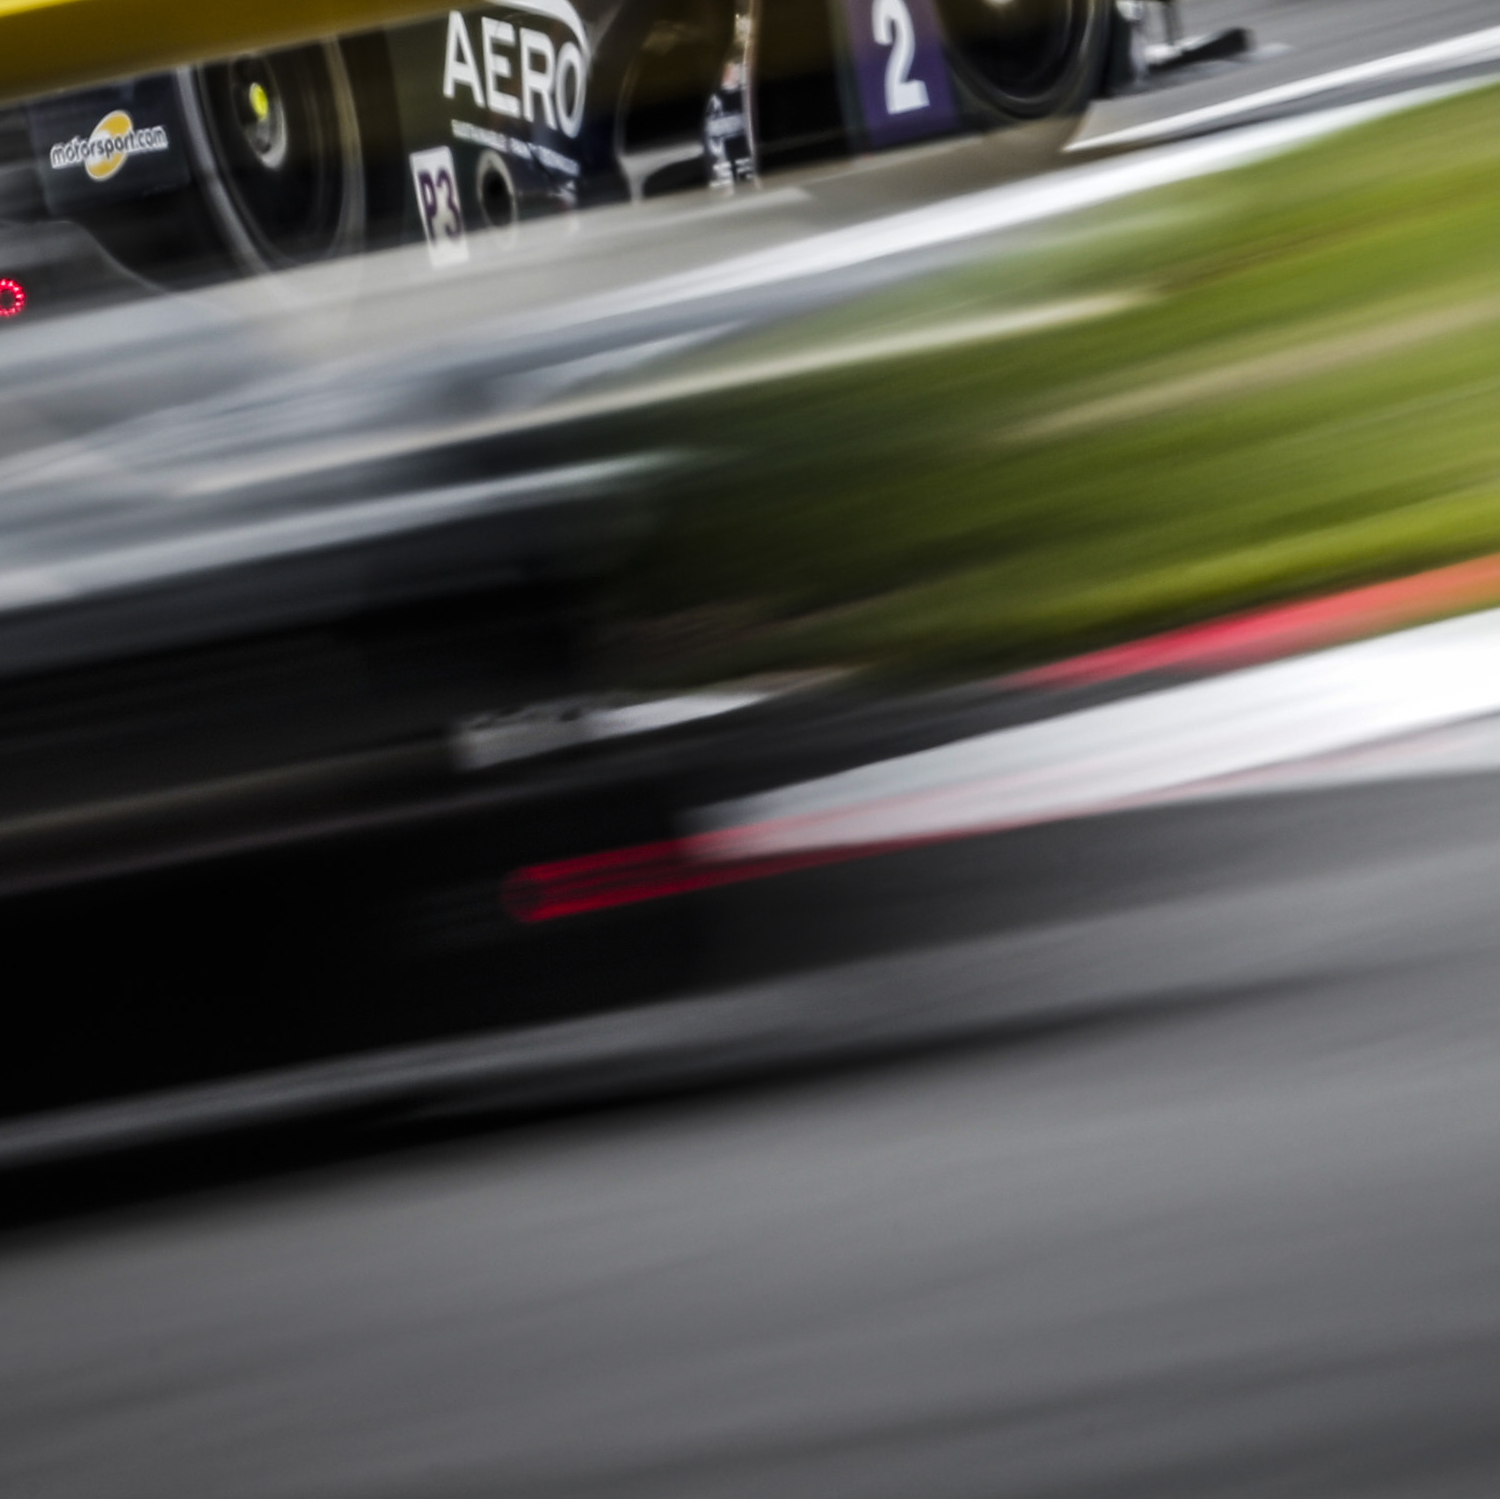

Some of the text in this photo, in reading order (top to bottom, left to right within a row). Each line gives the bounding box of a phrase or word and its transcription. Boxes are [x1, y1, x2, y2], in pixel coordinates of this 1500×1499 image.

[443, 10, 587, 138] AERO
[51, 128, 167, 167] motorsport.com
[418, 168, 463, 246] P3
